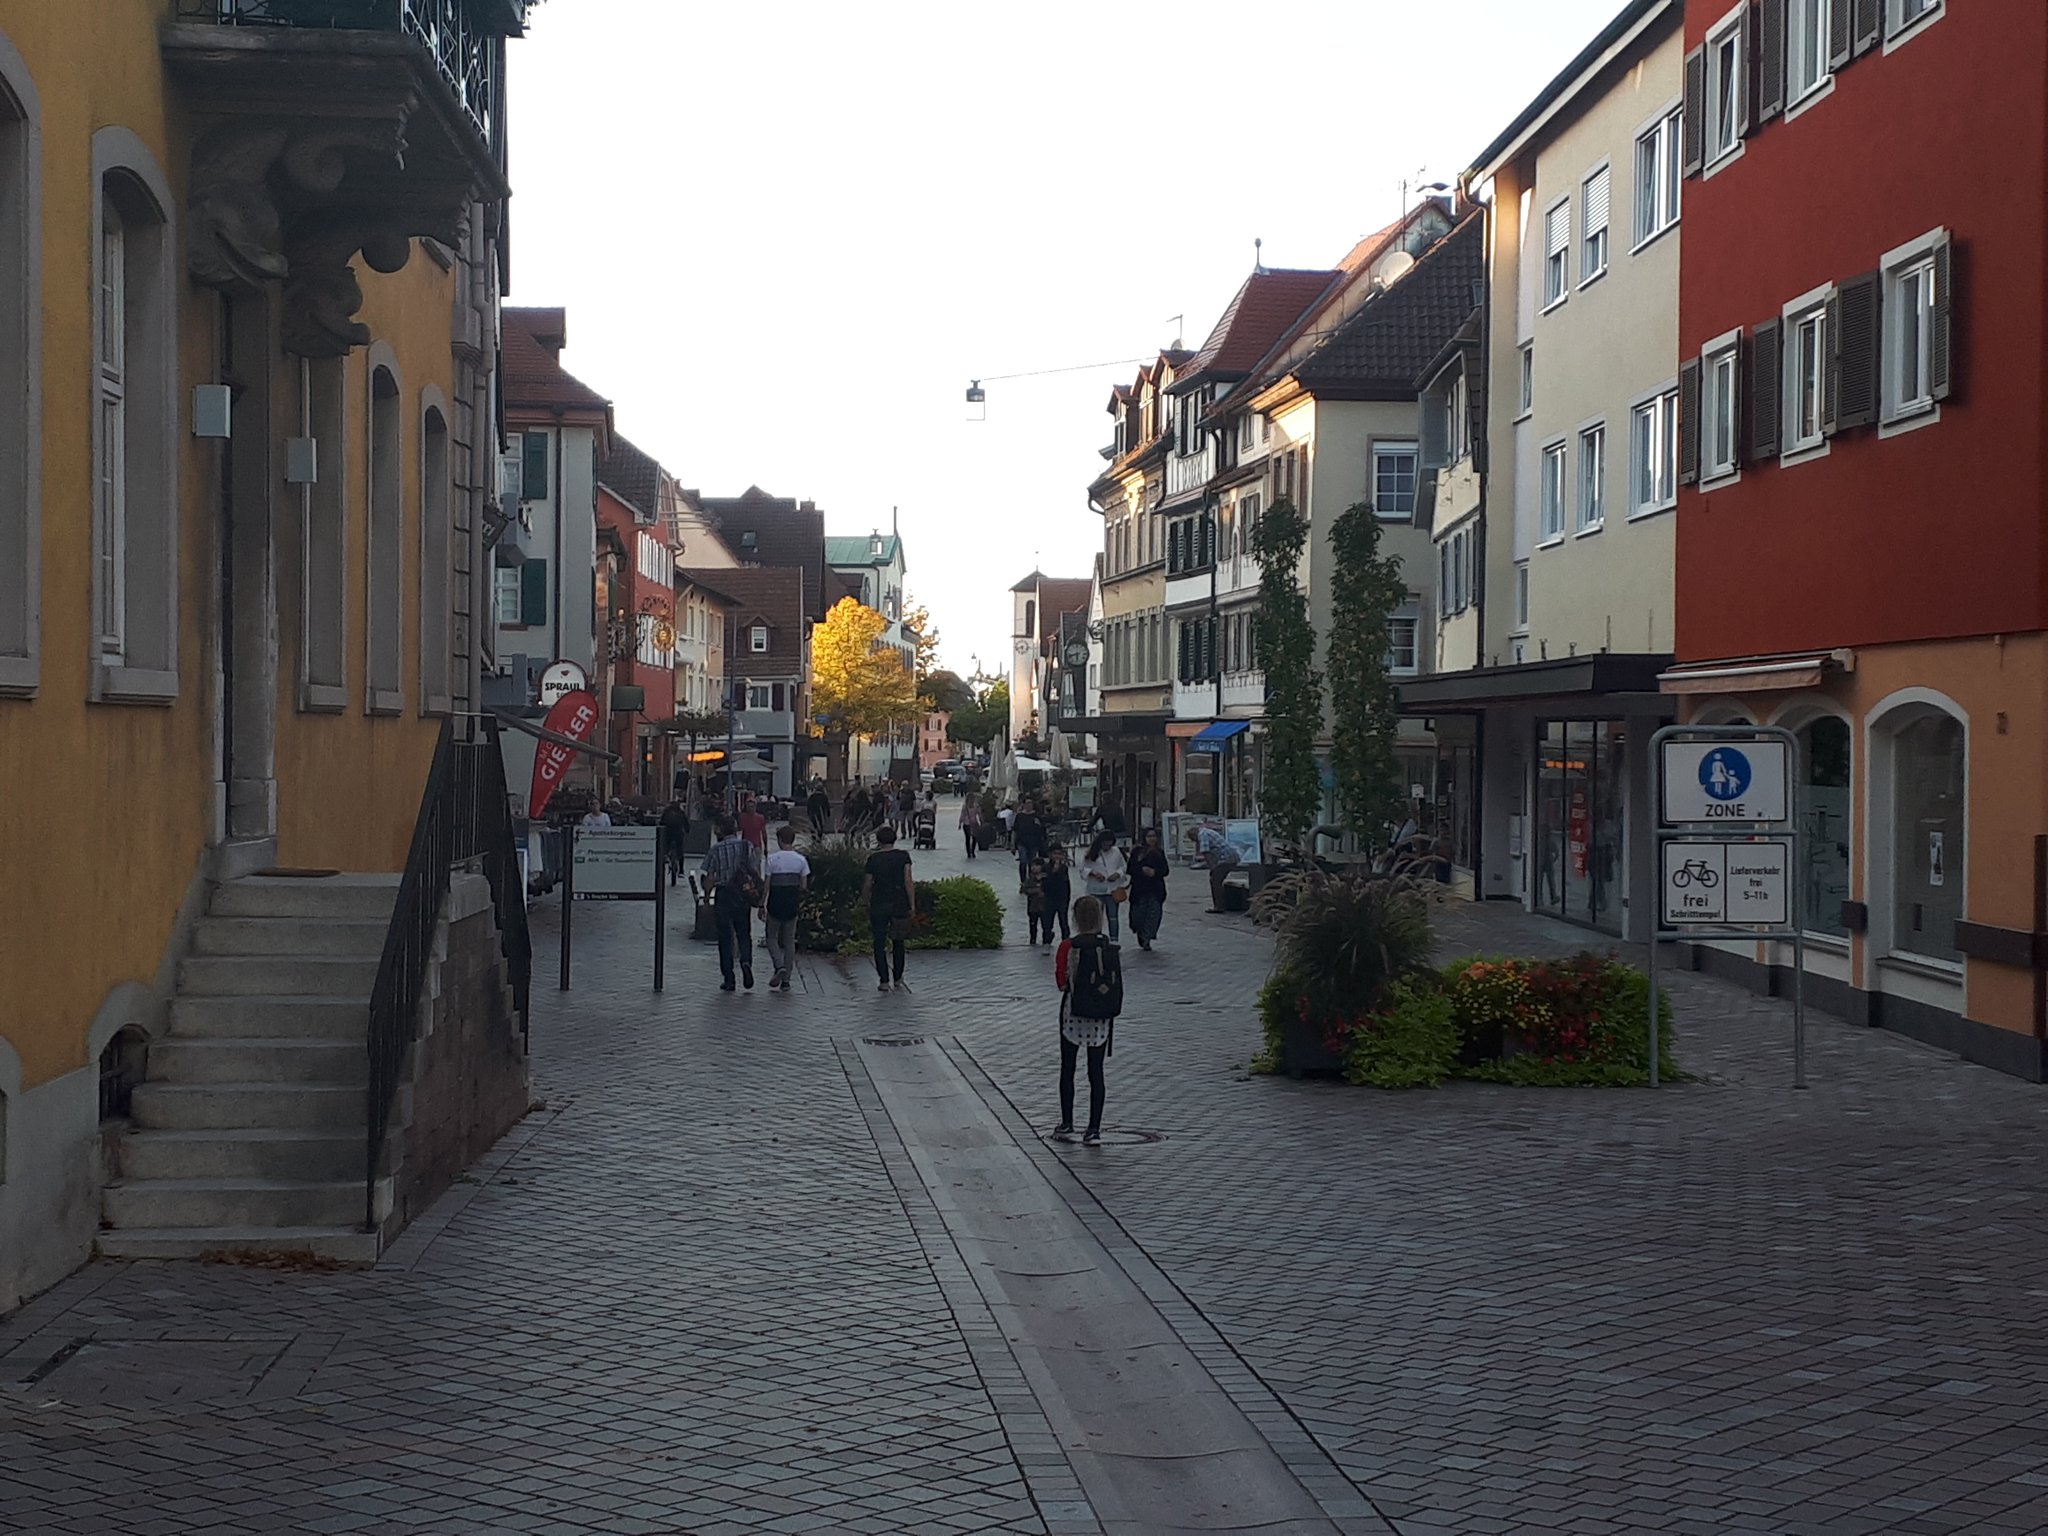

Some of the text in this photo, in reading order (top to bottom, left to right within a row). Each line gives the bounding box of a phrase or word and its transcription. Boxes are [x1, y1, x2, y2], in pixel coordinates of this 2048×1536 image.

[541, 704, 593, 780] GIELER
[1705, 803, 1745, 817] ZONE
[1730, 866, 1781, 875] Lieferverkehr
[1749, 878, 1763, 887] frei
[1683, 893, 1709, 907] frei
